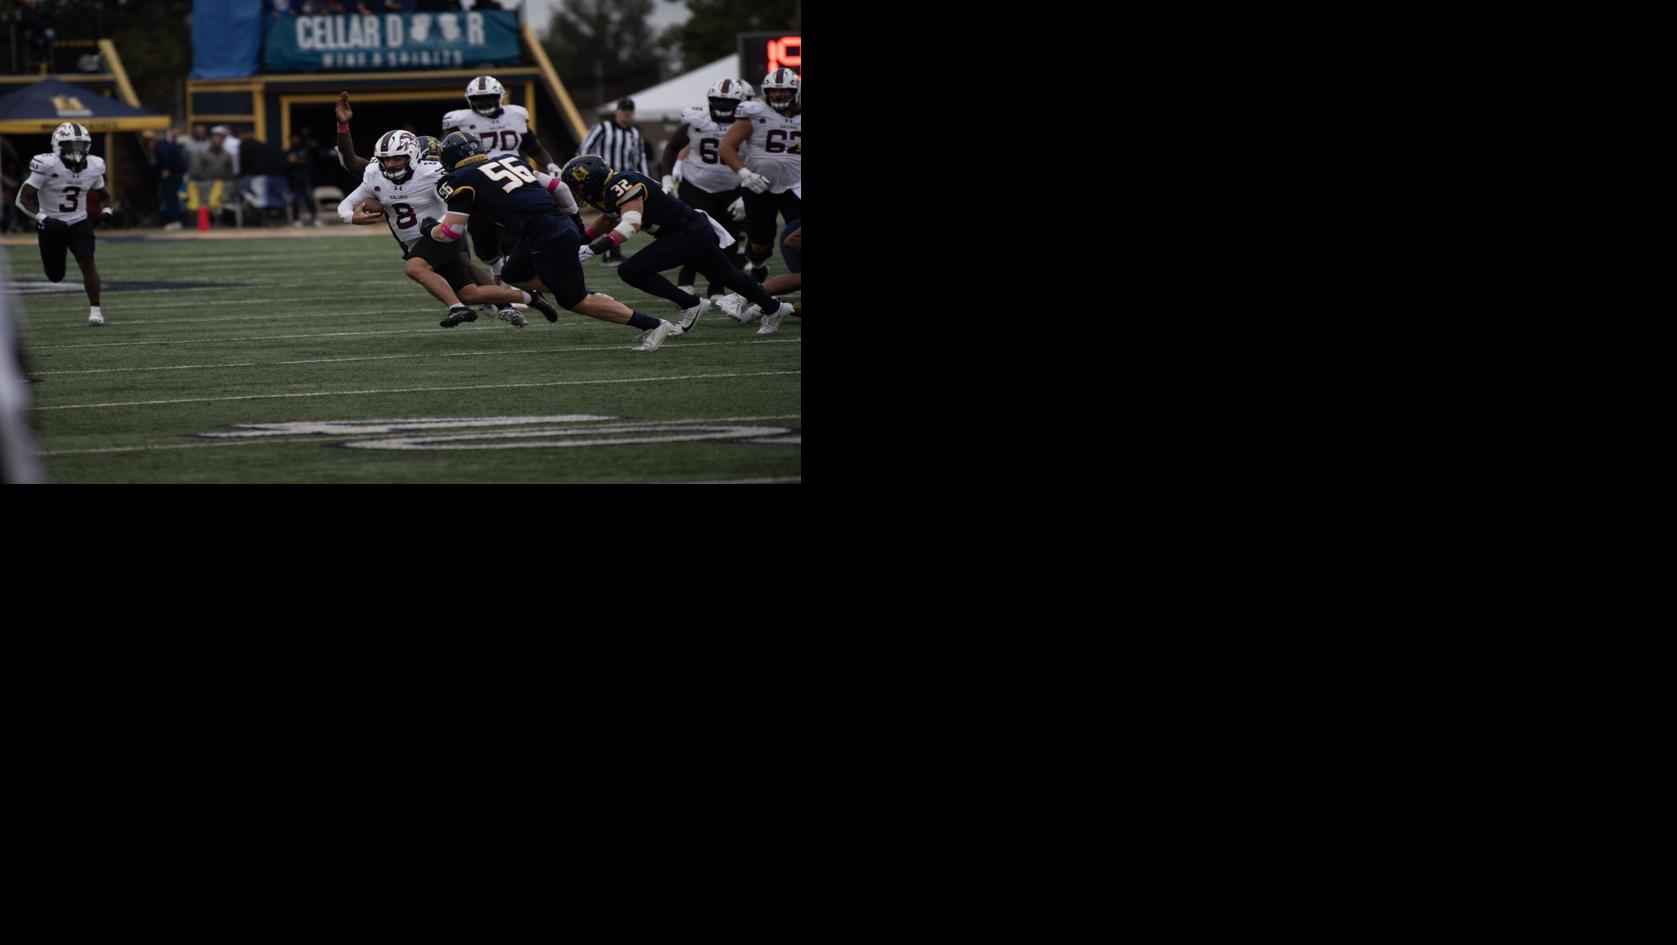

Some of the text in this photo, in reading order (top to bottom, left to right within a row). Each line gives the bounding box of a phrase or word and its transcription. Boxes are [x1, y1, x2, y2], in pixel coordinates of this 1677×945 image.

[296, 14, 381, 50] CELLAR
[480, 130, 518, 154] 70
[700, 138, 727, 165] 6
[766, 129, 801, 155] 62
[476, 156, 538, 194] 56
[610, 178, 633, 198] 32
[59, 186, 81, 213] 3
[439, 181, 454, 200] 56
[392, 203, 418, 230] 8
